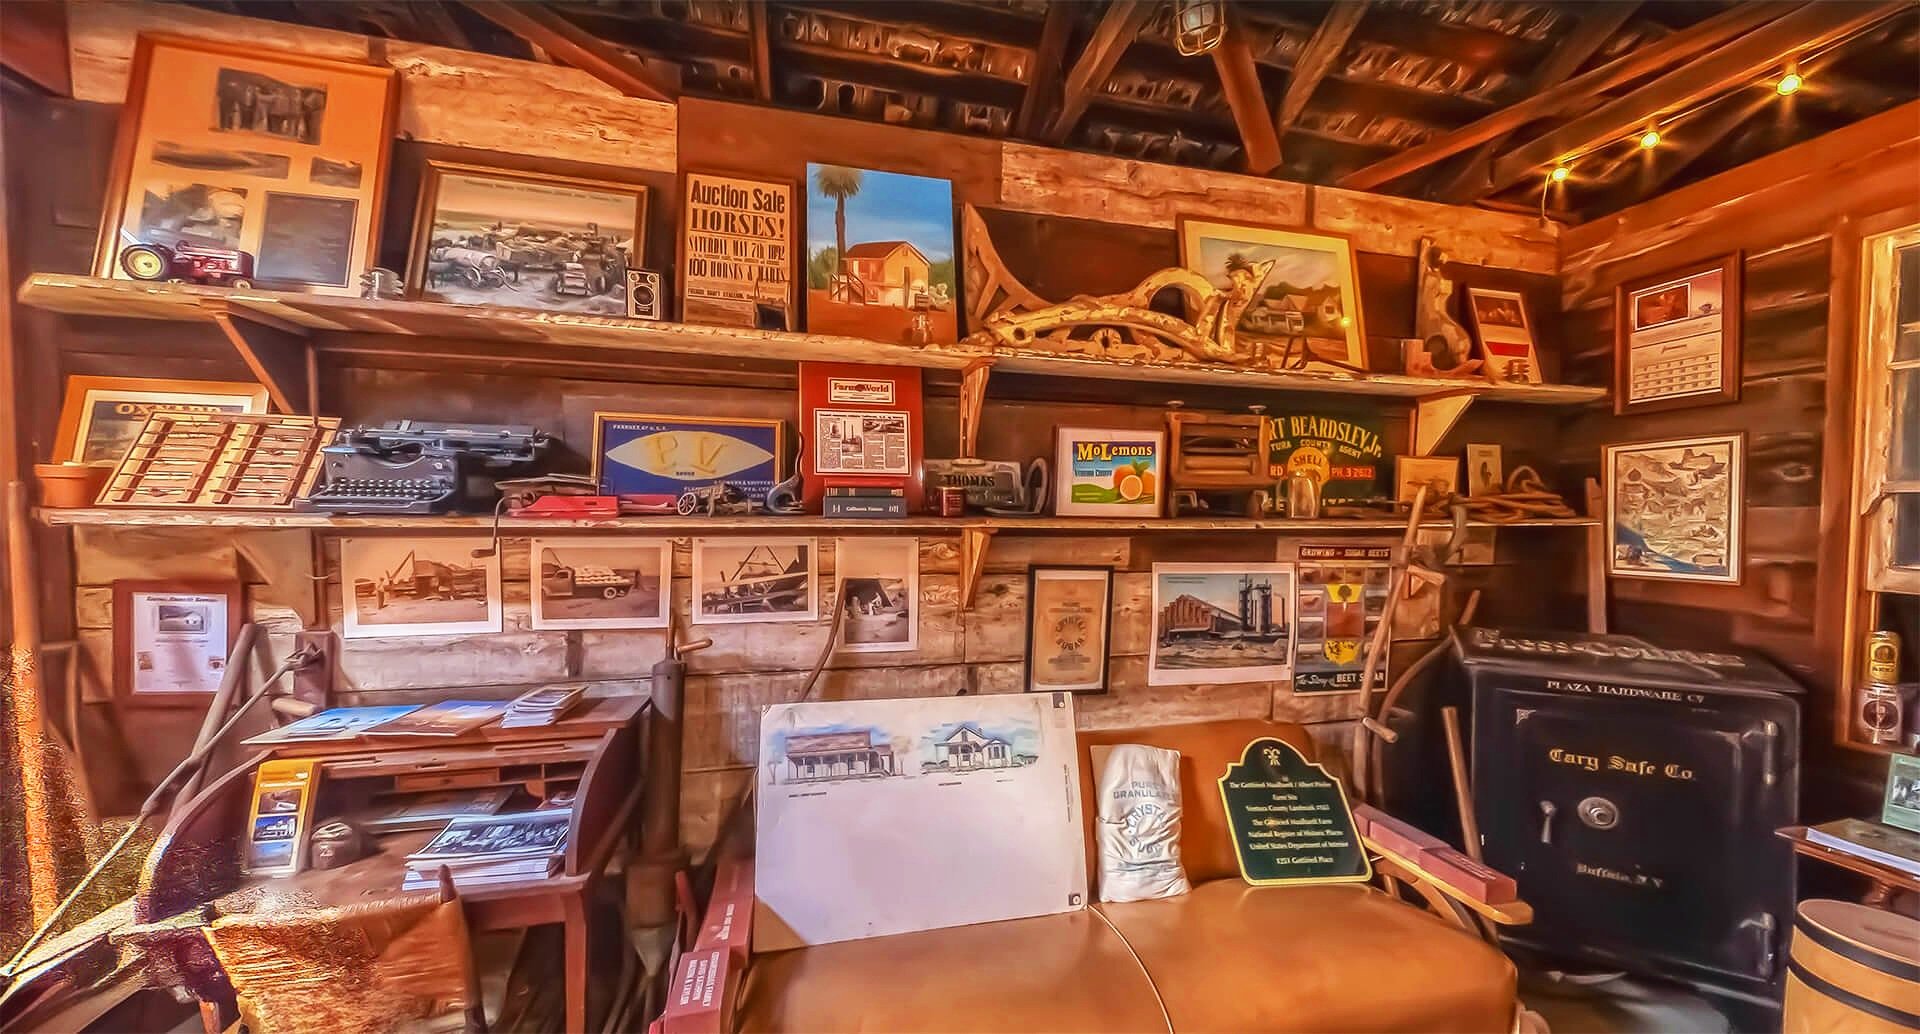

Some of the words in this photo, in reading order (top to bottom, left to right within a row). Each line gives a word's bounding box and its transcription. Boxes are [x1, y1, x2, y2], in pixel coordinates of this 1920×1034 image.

[691, 180, 748, 209] Auction
[752, 188, 785, 213] Sale
[691, 208, 785, 238] HORSES!
[689, 258, 707, 277] 100
[710, 260, 743, 280] HORSES
[833, 382, 858, 391] Farm
[863, 383, 889, 393] World
[1300, 439, 1332, 450] COUNTY
[1339, 444, 1361, 459] AGENT
[1293, 454, 1322, 466] SHELL
[945, 474, 995, 487] THOMAS
[1336, 673, 1357, 683] BEET
[1359, 672, 1385, 682] SAR
[1547, 680, 1592, 694] PLAZA
[1597, 684, 1682, 702] HARDWARE
[1549, 748, 1599, 771] Cary
[1607, 754, 1655, 776] Safe
